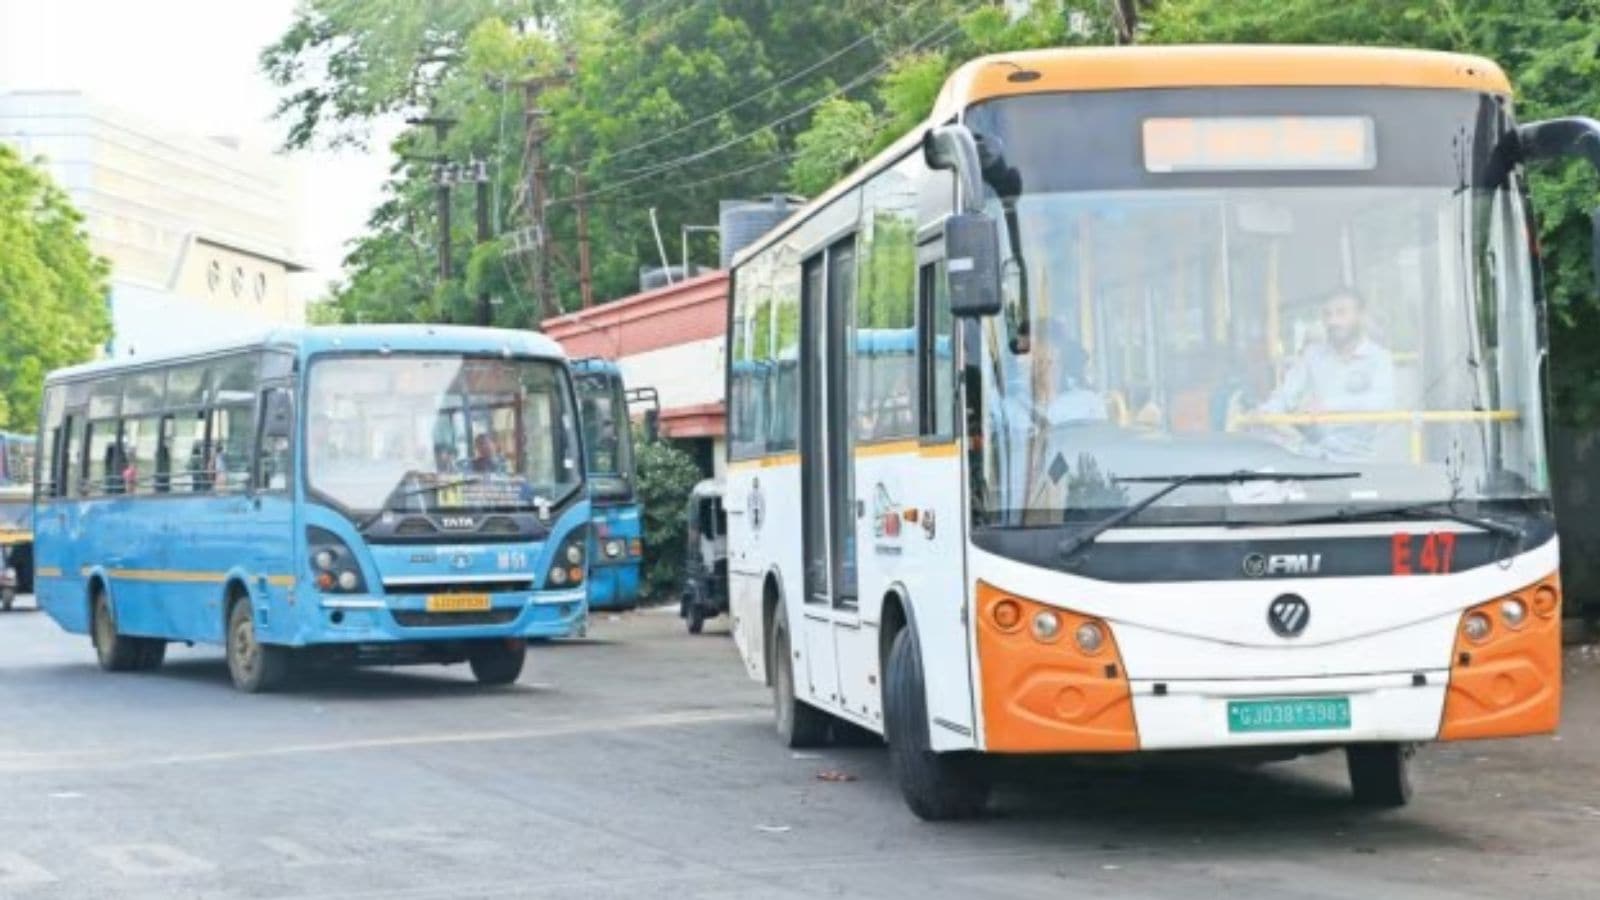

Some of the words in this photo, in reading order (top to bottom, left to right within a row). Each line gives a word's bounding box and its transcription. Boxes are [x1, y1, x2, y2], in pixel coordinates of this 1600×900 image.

[442, 518, 473, 528] TATA
[1392, 532, 1411, 576] E
[1420, 532, 1456, 576] 47
